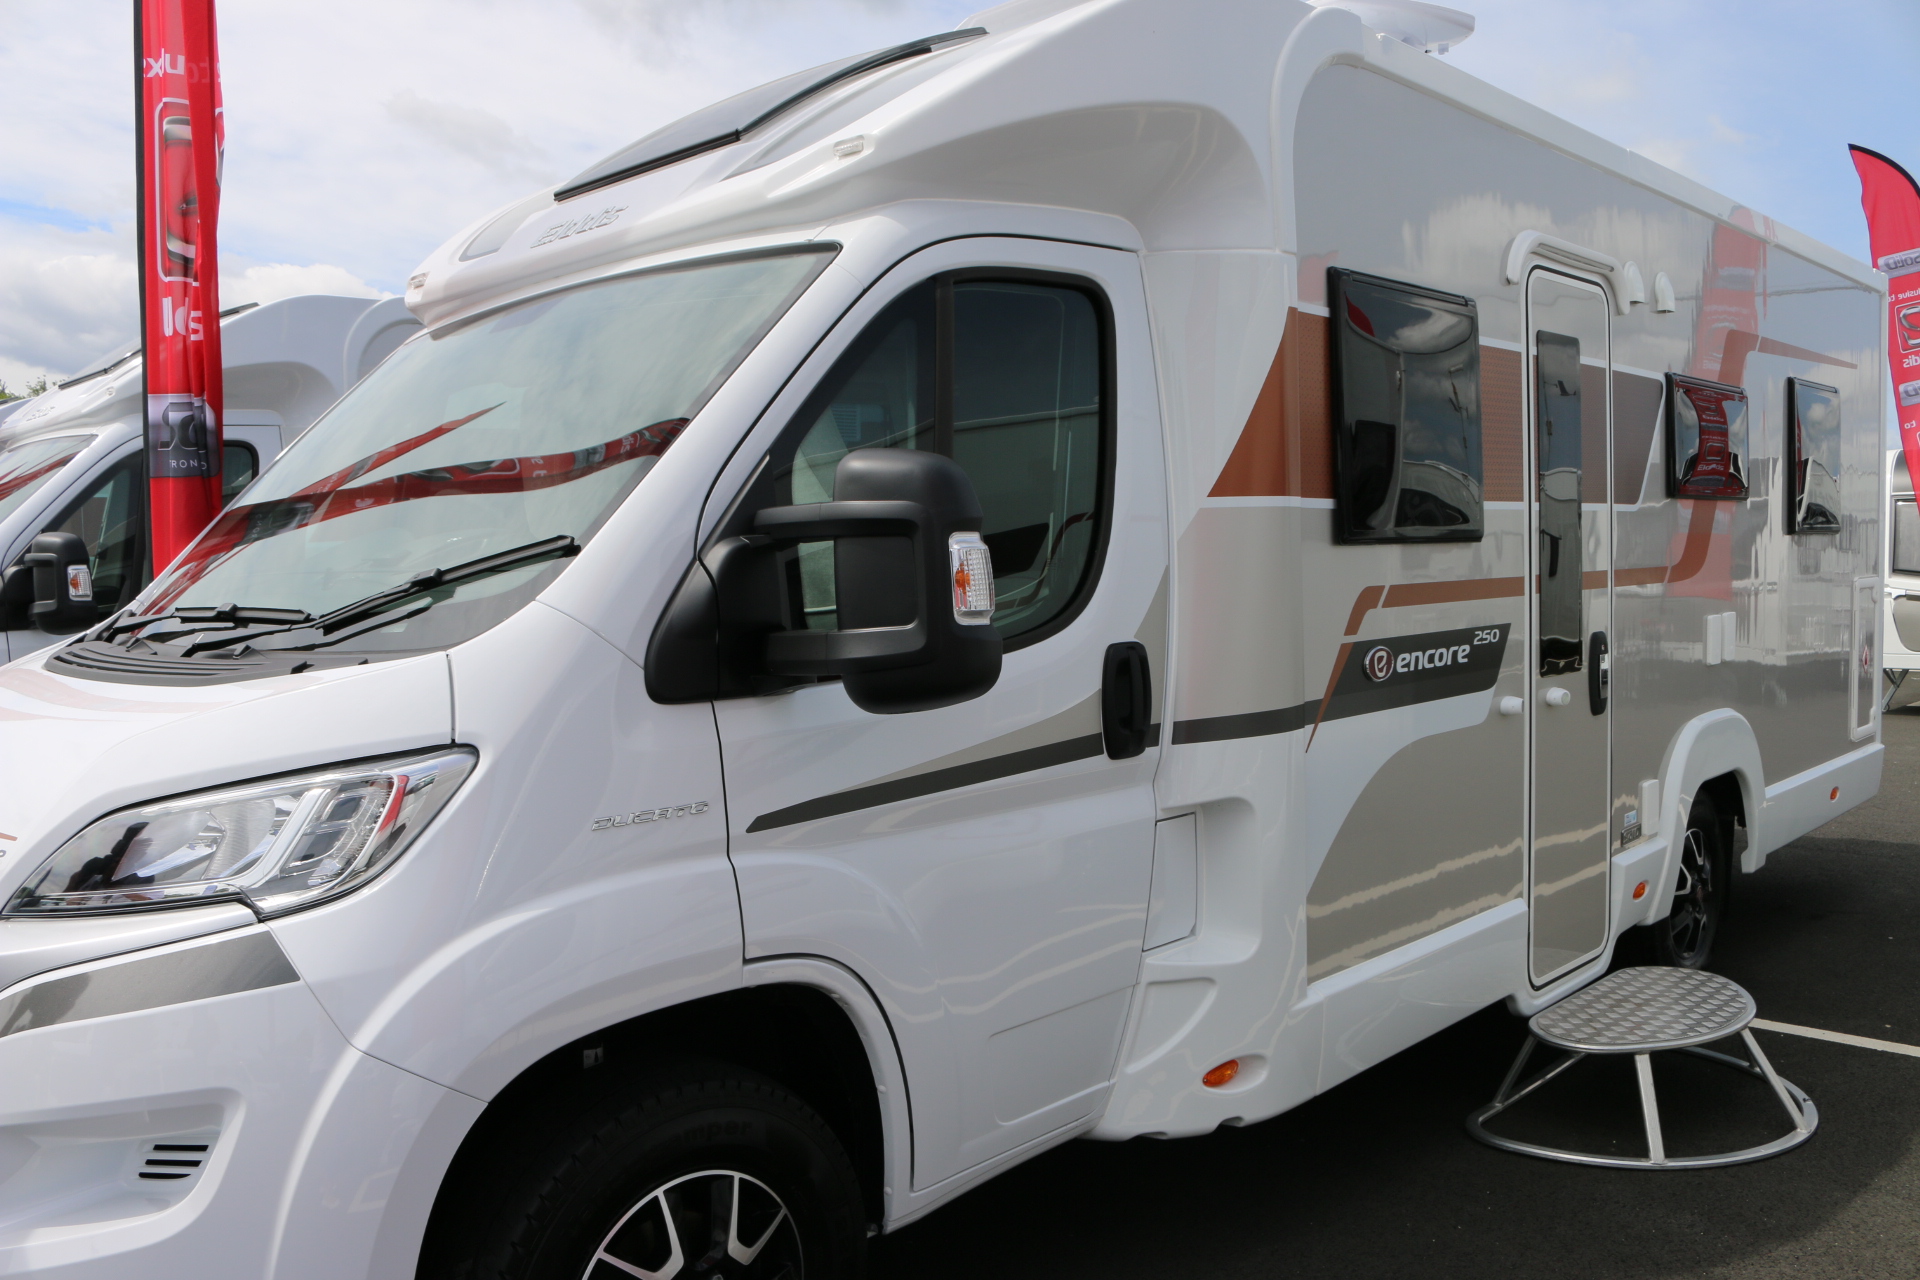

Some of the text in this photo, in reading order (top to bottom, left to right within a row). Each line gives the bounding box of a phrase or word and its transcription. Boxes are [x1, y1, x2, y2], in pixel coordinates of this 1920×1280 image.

[1396, 644, 1471, 673] encore
[1473, 628, 1500, 646] 250
[591, 801, 709, 831] DUCATO
